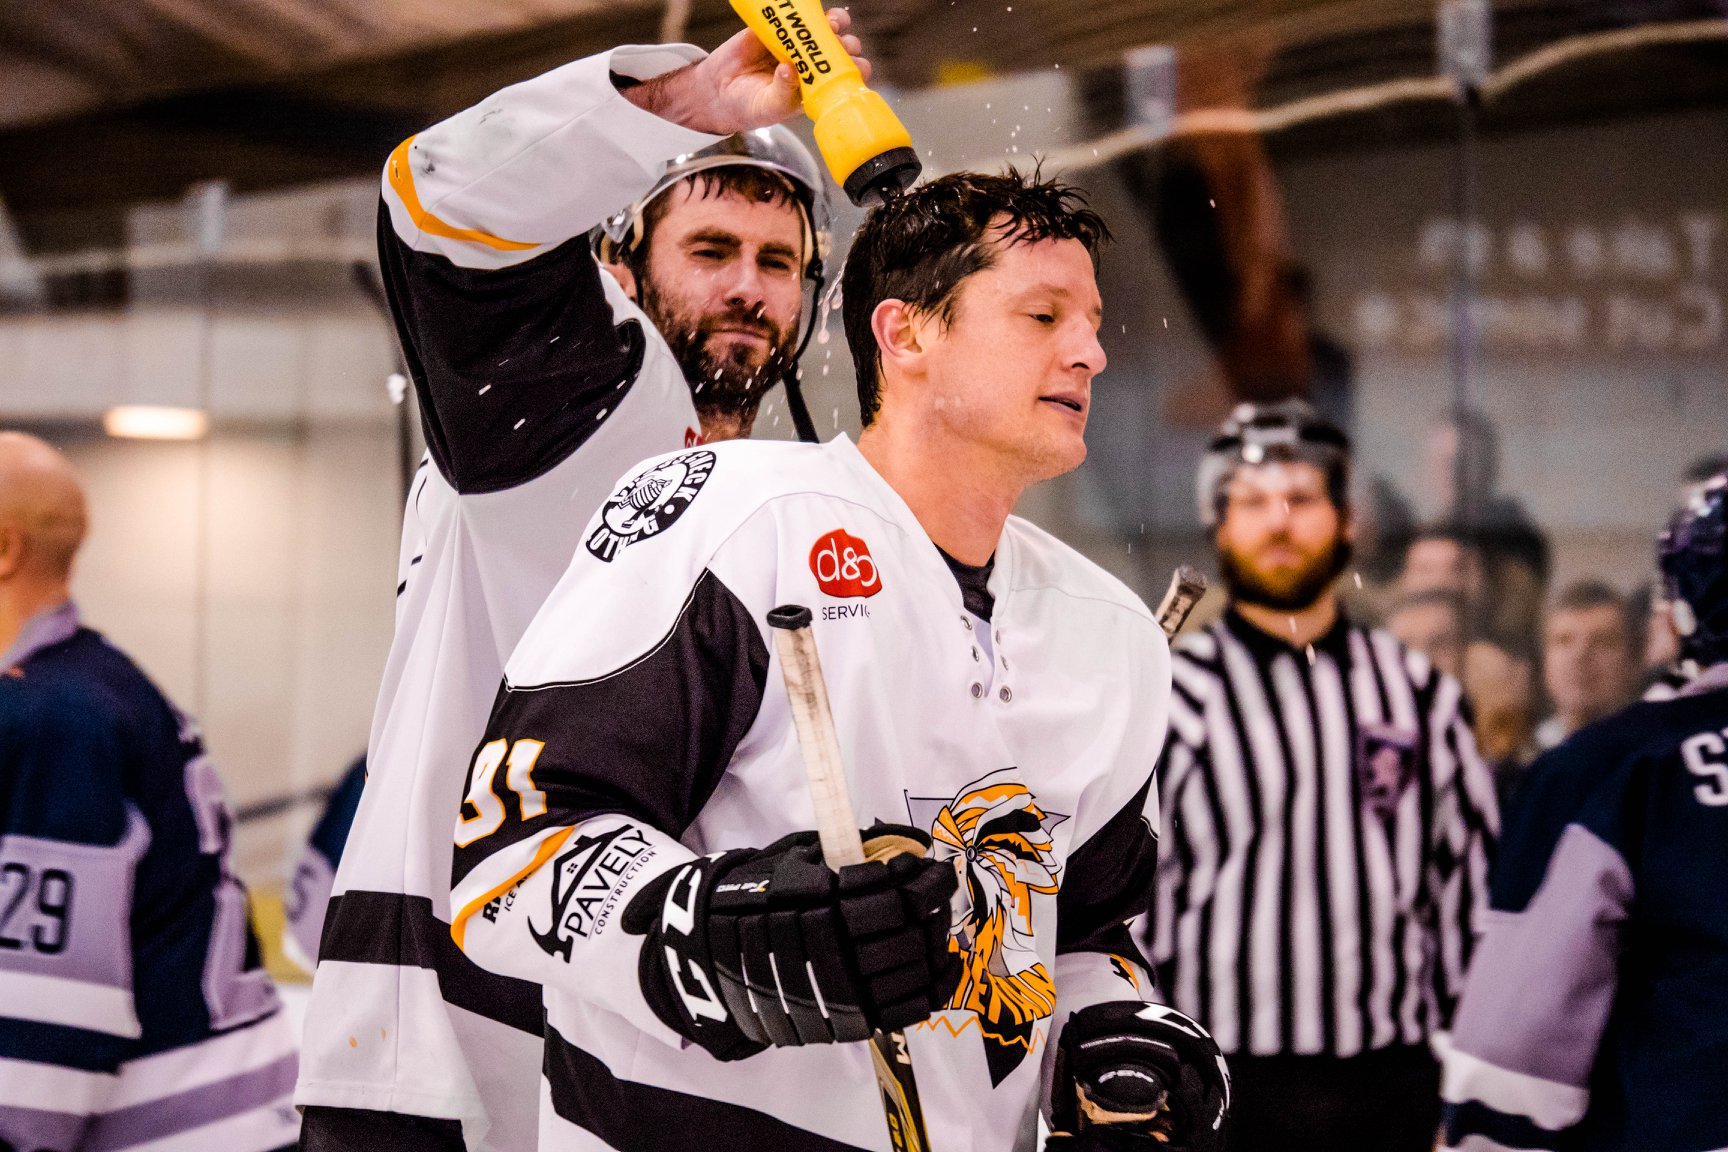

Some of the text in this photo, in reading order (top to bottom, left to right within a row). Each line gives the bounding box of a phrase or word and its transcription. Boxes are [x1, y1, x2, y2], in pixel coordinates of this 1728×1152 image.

[761, 6, 809, 74] SPORTS
[1680, 726, 1728, 806] S
[0, 861, 74, 955] 29
[504, 889, 517, 912] ICE
[564, 829, 653, 938] PAVELY
[594, 850, 658, 935] CONSTRUCTION
